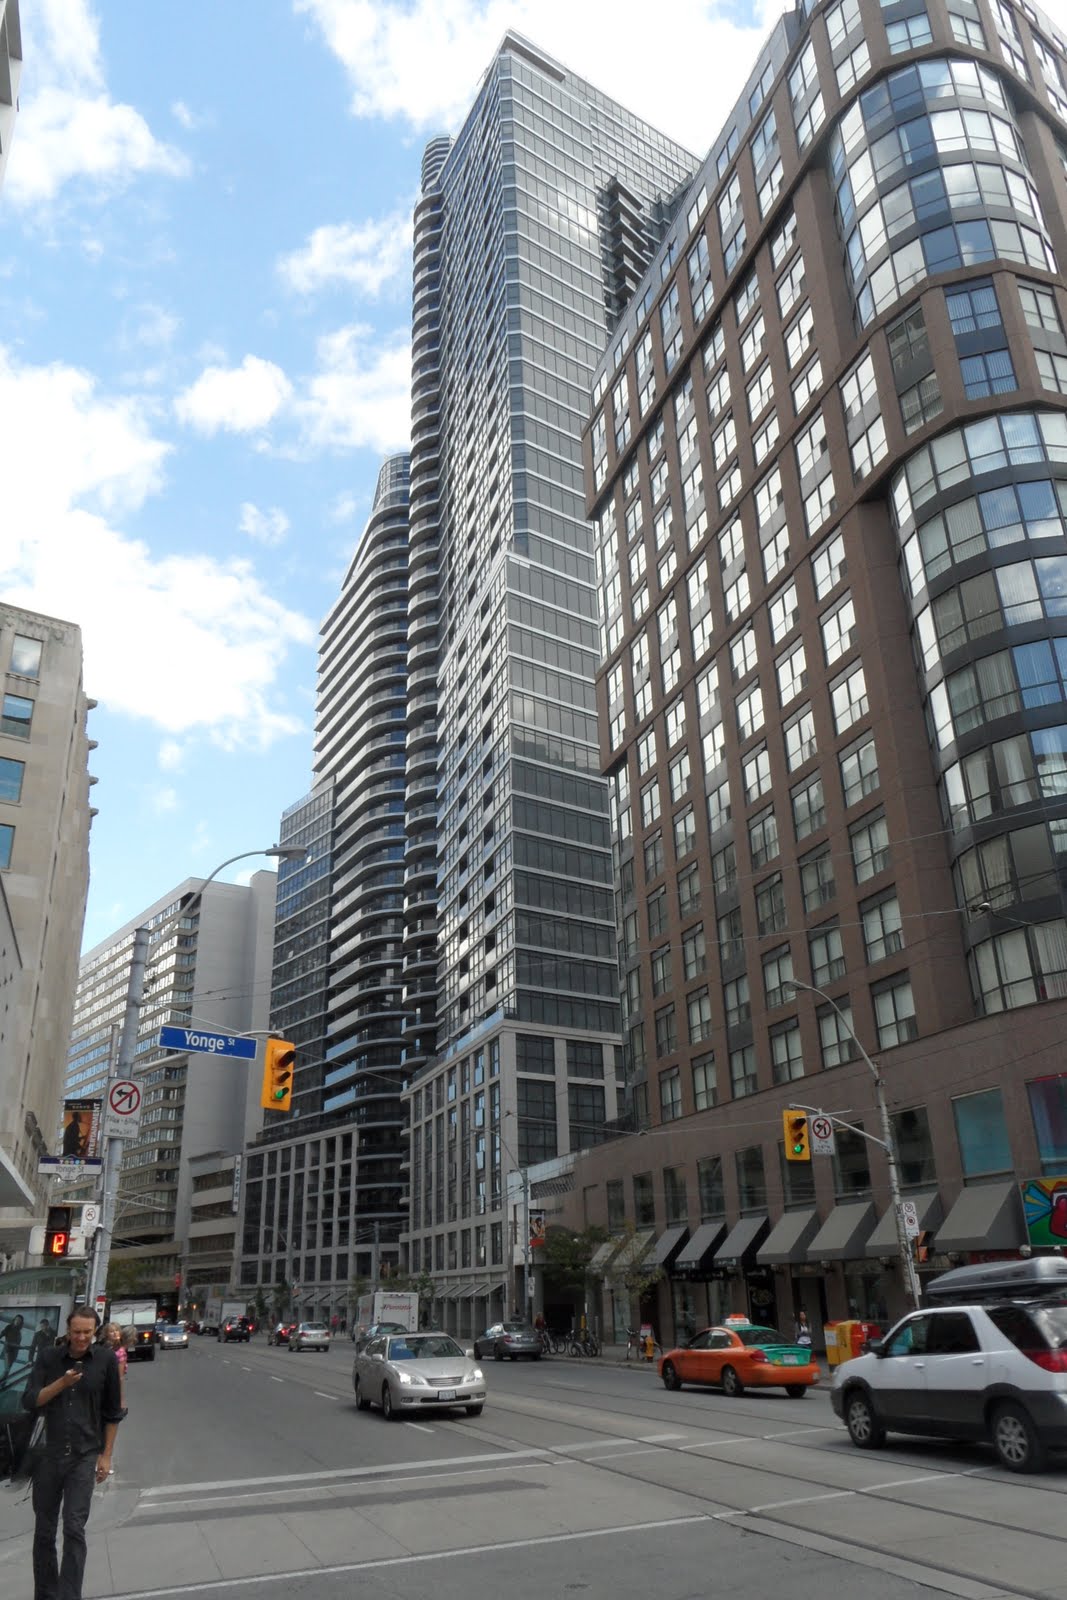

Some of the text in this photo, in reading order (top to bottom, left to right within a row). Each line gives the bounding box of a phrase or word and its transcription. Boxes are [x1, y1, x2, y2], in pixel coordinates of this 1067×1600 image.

[184, 1031, 236, 1053] Yonge St
[87, 1102, 101, 1157] NTERTAINMENT
[52, 1233, 66, 1254] 12
